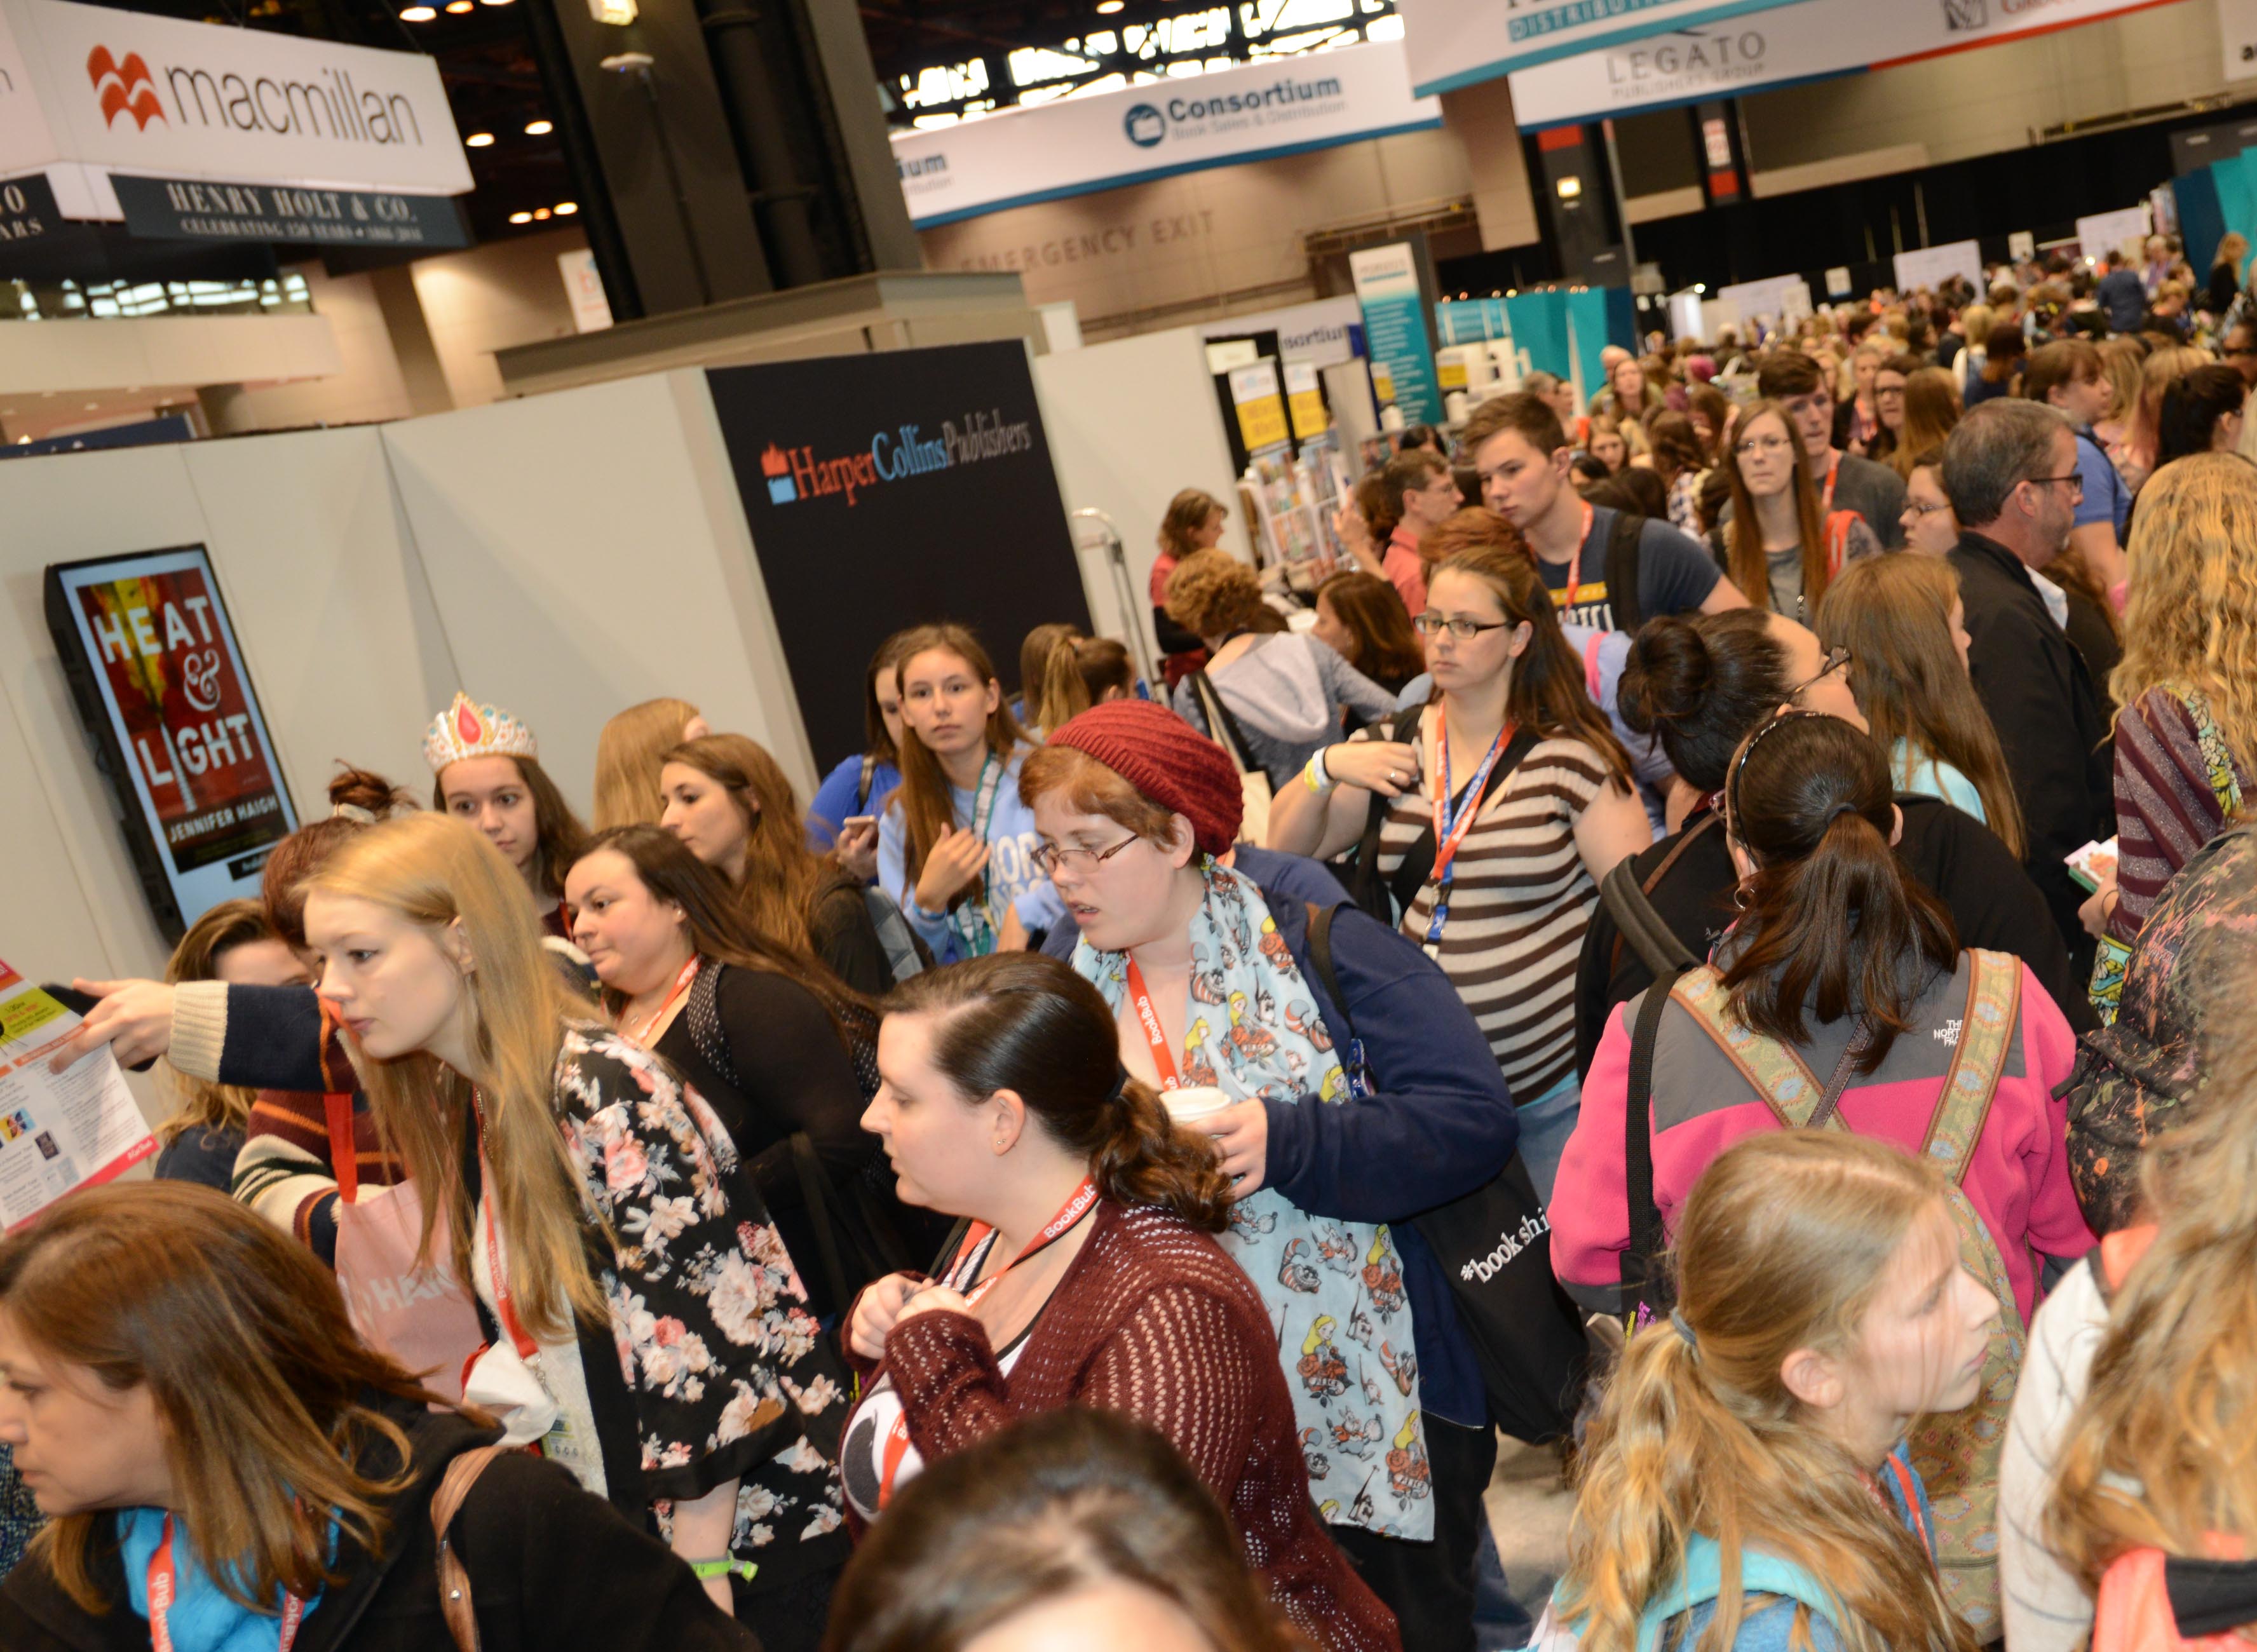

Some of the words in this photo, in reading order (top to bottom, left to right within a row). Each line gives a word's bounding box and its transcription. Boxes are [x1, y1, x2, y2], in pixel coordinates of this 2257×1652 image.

[1511, 0, 1657, 39] DISTRIBU
[1606, 30, 1766, 84] LEGATO
[166, 65, 423, 146] macmillan
[1168, 76, 1342, 122] Consortium
[166, 182, 263, 216] HENRY
[271, 188, 343, 220] HOLT
[350, 193, 370, 221] &
[374, 195, 417, 224] CO.
[1151, 210, 1214, 244] EXIT
[787, 408, 1032, 506] HarperCollinsPublishers
[93, 596, 214, 663] HEAT
[184, 649, 220, 712] &
[138, 714, 254, 812] LIGHT
[169, 809, 236, 844] JENNIFER
[236, 794, 279, 822] HAIGH
[1137, 996, 1163, 1046] BookBub
[1933, 1028, 1961, 1040] NORT
[1944, 1036, 1958, 1047] FAC
